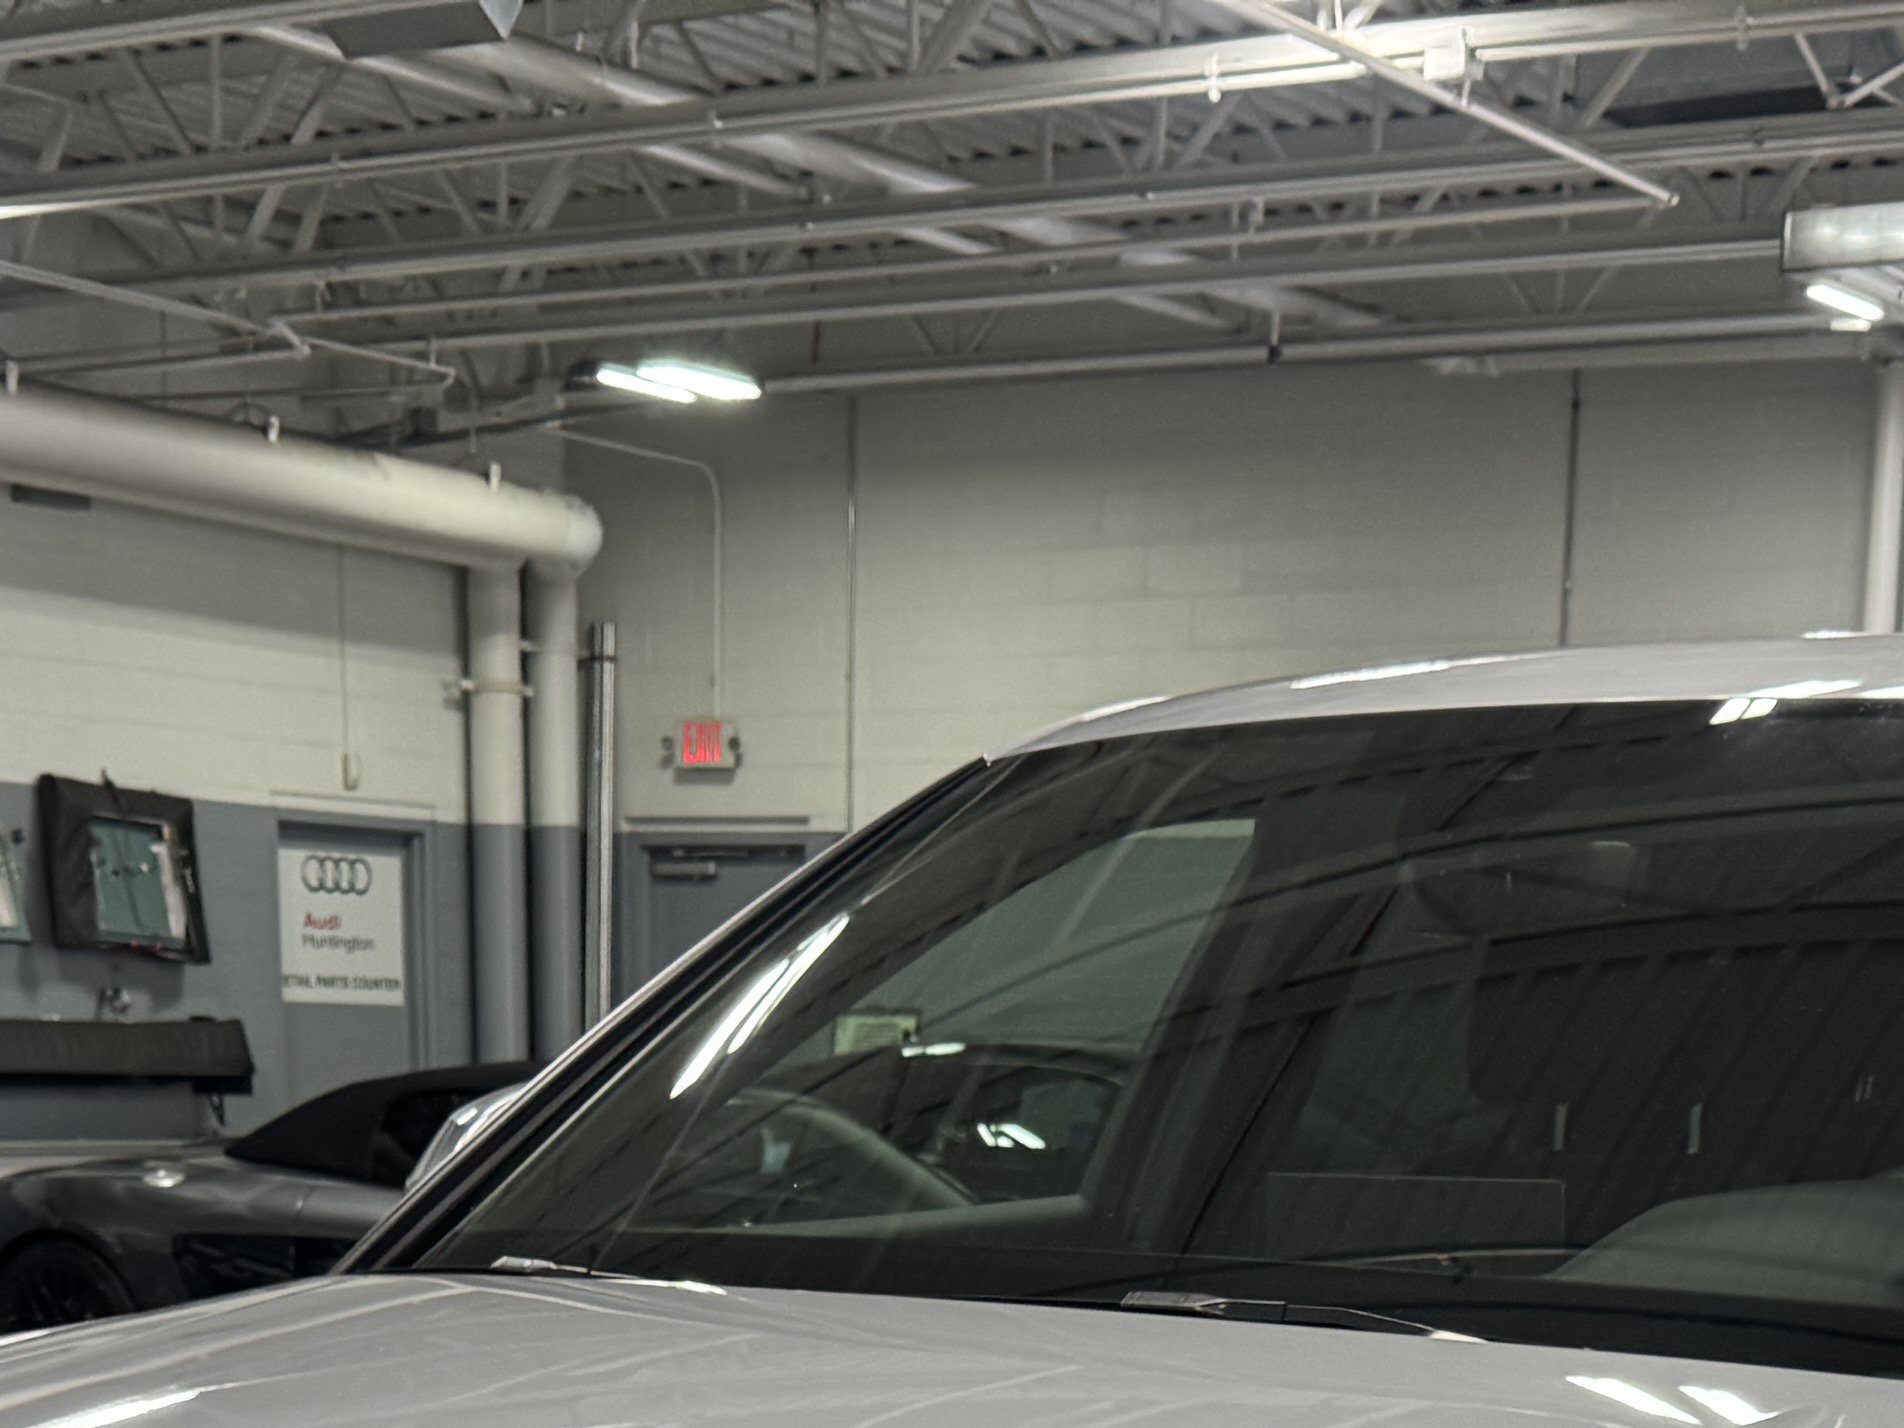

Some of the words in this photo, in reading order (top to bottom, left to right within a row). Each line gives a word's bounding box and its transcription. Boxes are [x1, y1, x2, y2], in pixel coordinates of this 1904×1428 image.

[683, 721, 722, 765] EXIT
[303, 911, 342, 930] Audi
[301, 934, 375, 954] Huntington
[351, 976, 400, 992] COUNTER
